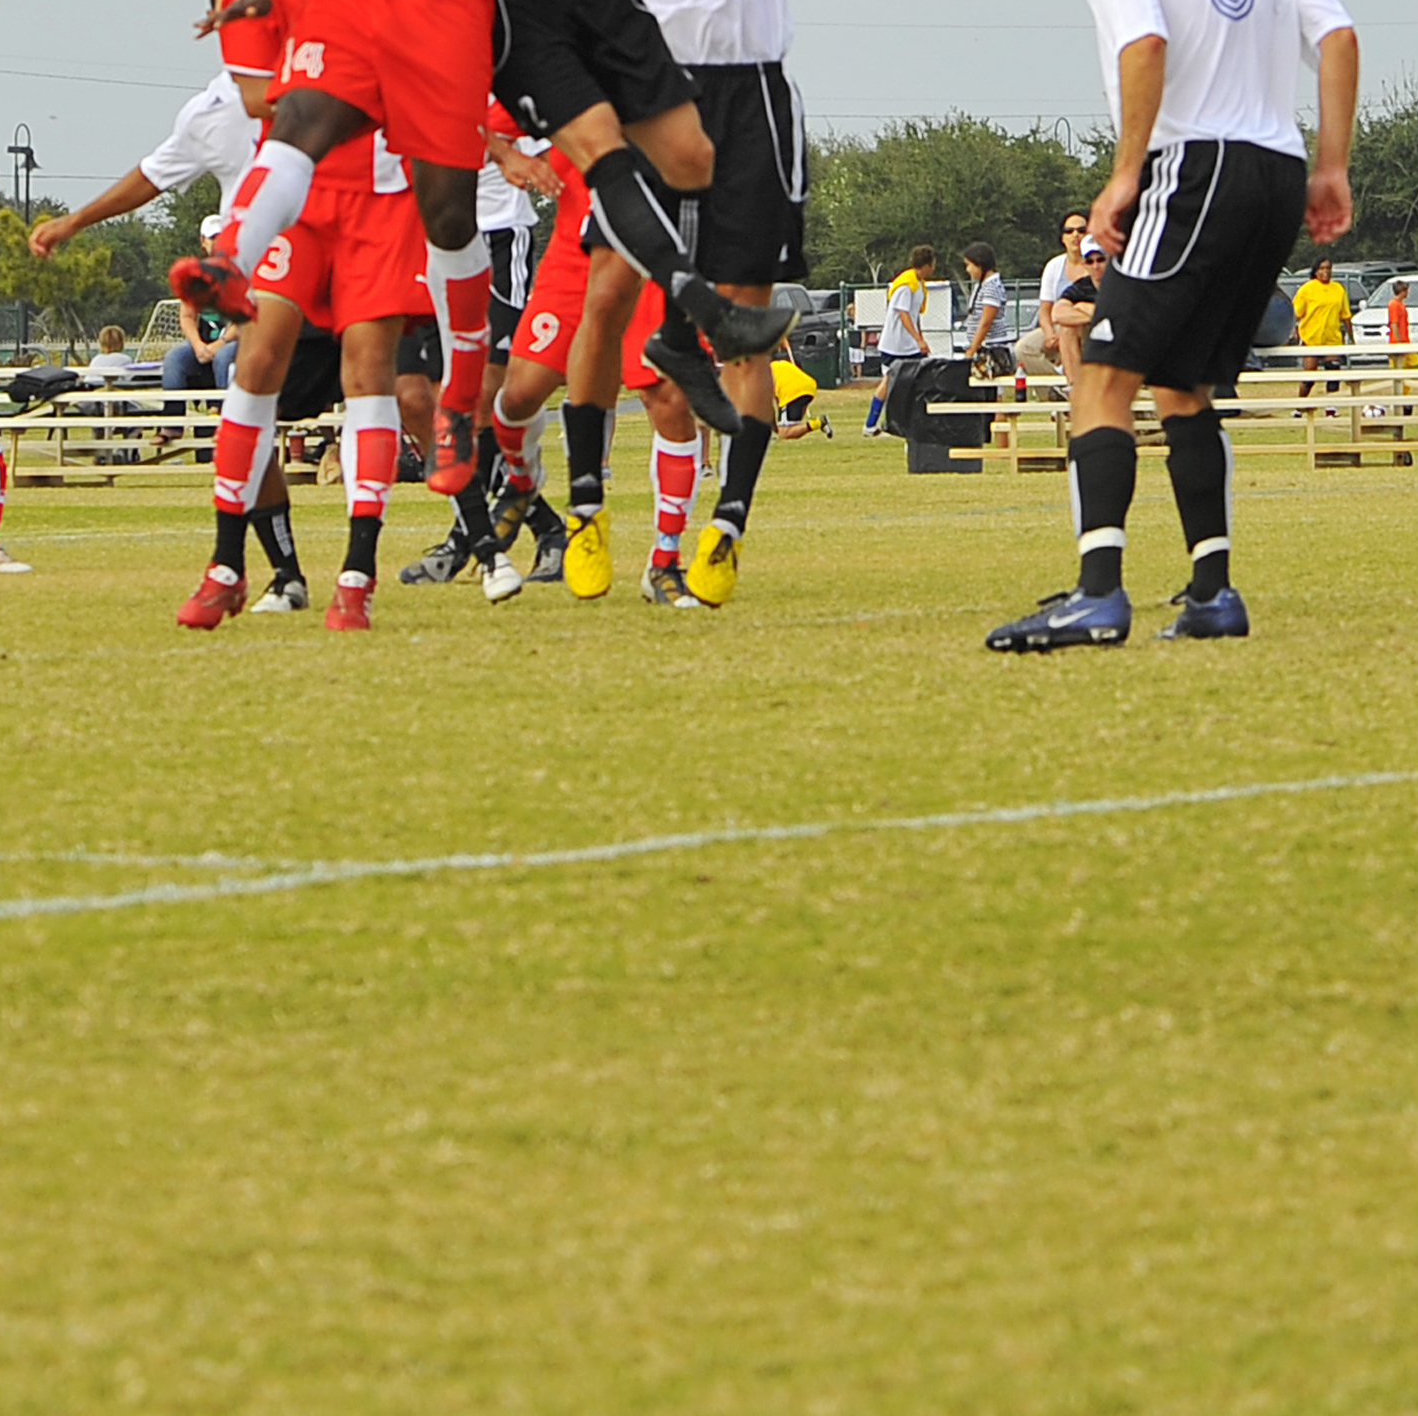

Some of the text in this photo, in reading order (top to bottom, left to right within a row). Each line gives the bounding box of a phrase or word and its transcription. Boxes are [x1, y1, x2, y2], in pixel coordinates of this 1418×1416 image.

[280, 36, 325, 84] 14
[256, 234, 292, 281] 3
[528, 311, 560, 353] 9
